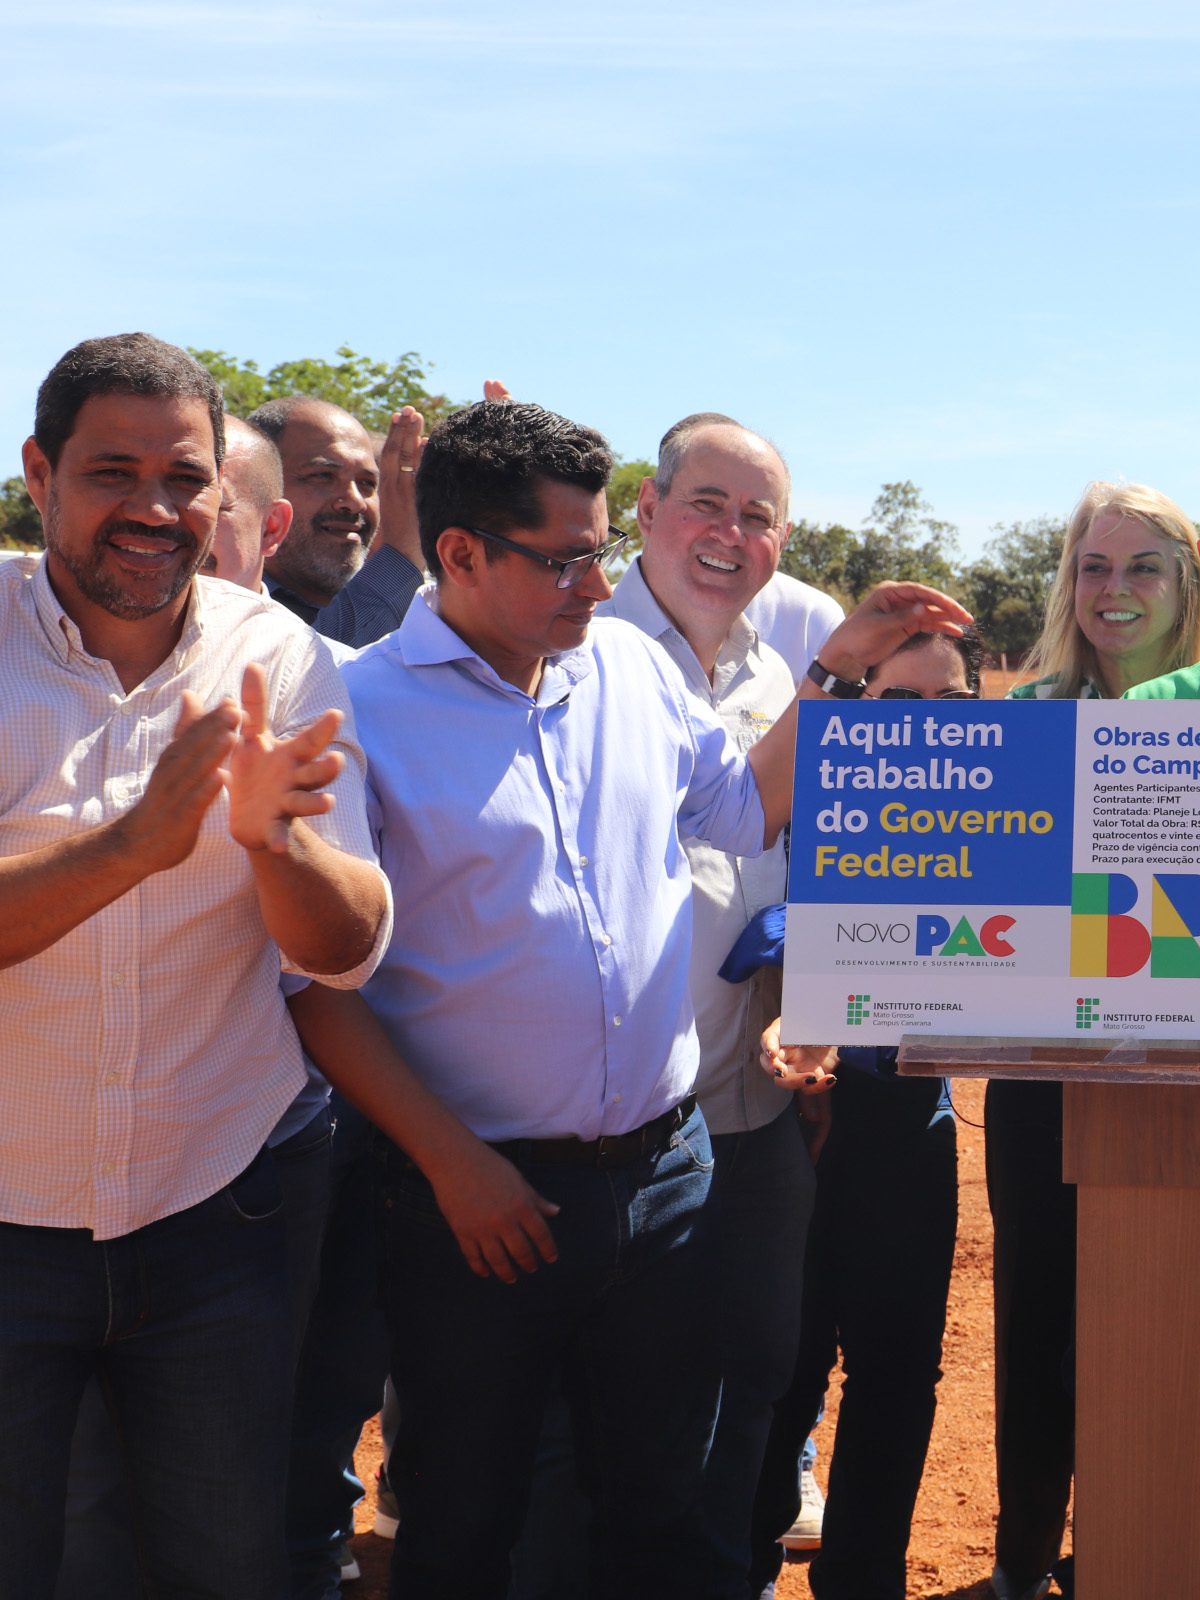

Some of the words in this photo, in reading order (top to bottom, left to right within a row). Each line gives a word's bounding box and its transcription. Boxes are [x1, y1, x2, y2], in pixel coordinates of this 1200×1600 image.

[820, 715, 911, 754] Aqui
[923, 716, 1003, 747] tem
[1093, 726, 1170, 747] Obras
[1092, 755, 1126, 775] do
[819, 758, 993, 790] trabalho
[1093, 784, 1134, 793] Agentes
[1093, 796, 1155, 804] Contratante:
[1157, 796, 1181, 804] IFMT
[1093, 807, 1151, 816] Contratada:
[1153, 808, 1190, 818] Planeje
[816, 801, 869, 833] do
[879, 802, 1054, 835] Governo
[1093, 820, 1119, 828] Valor
[1120, 820, 1145, 828] Total
[1147, 820, 1160, 828] da
[1162, 820, 1188, 828] Obra:
[1092, 832, 1158, 842] quatrocentos
[1169, 832, 1193, 840] vinte
[1092, 843, 1120, 852] Prazo
[1122, 843, 1135, 852] de
[1137, 844, 1178, 853] vigência
[814, 845, 973, 878] Federal
[1092, 855, 1120, 863] Prazo
[1122, 857, 1144, 865] para
[1146, 856, 1194, 865] execução
[837, 923, 911, 943] NOVO
[915, 914, 1017, 957] PAC
[873, 1002, 922, 1011] INSTITUTO
[924, 1002, 963, 1011] FEDERAL
[872, 1019, 900, 1027] Campus
[1103, 1014, 1153, 1022] INSTITUTO
[1155, 1014, 1195, 1023] FEDERAL
